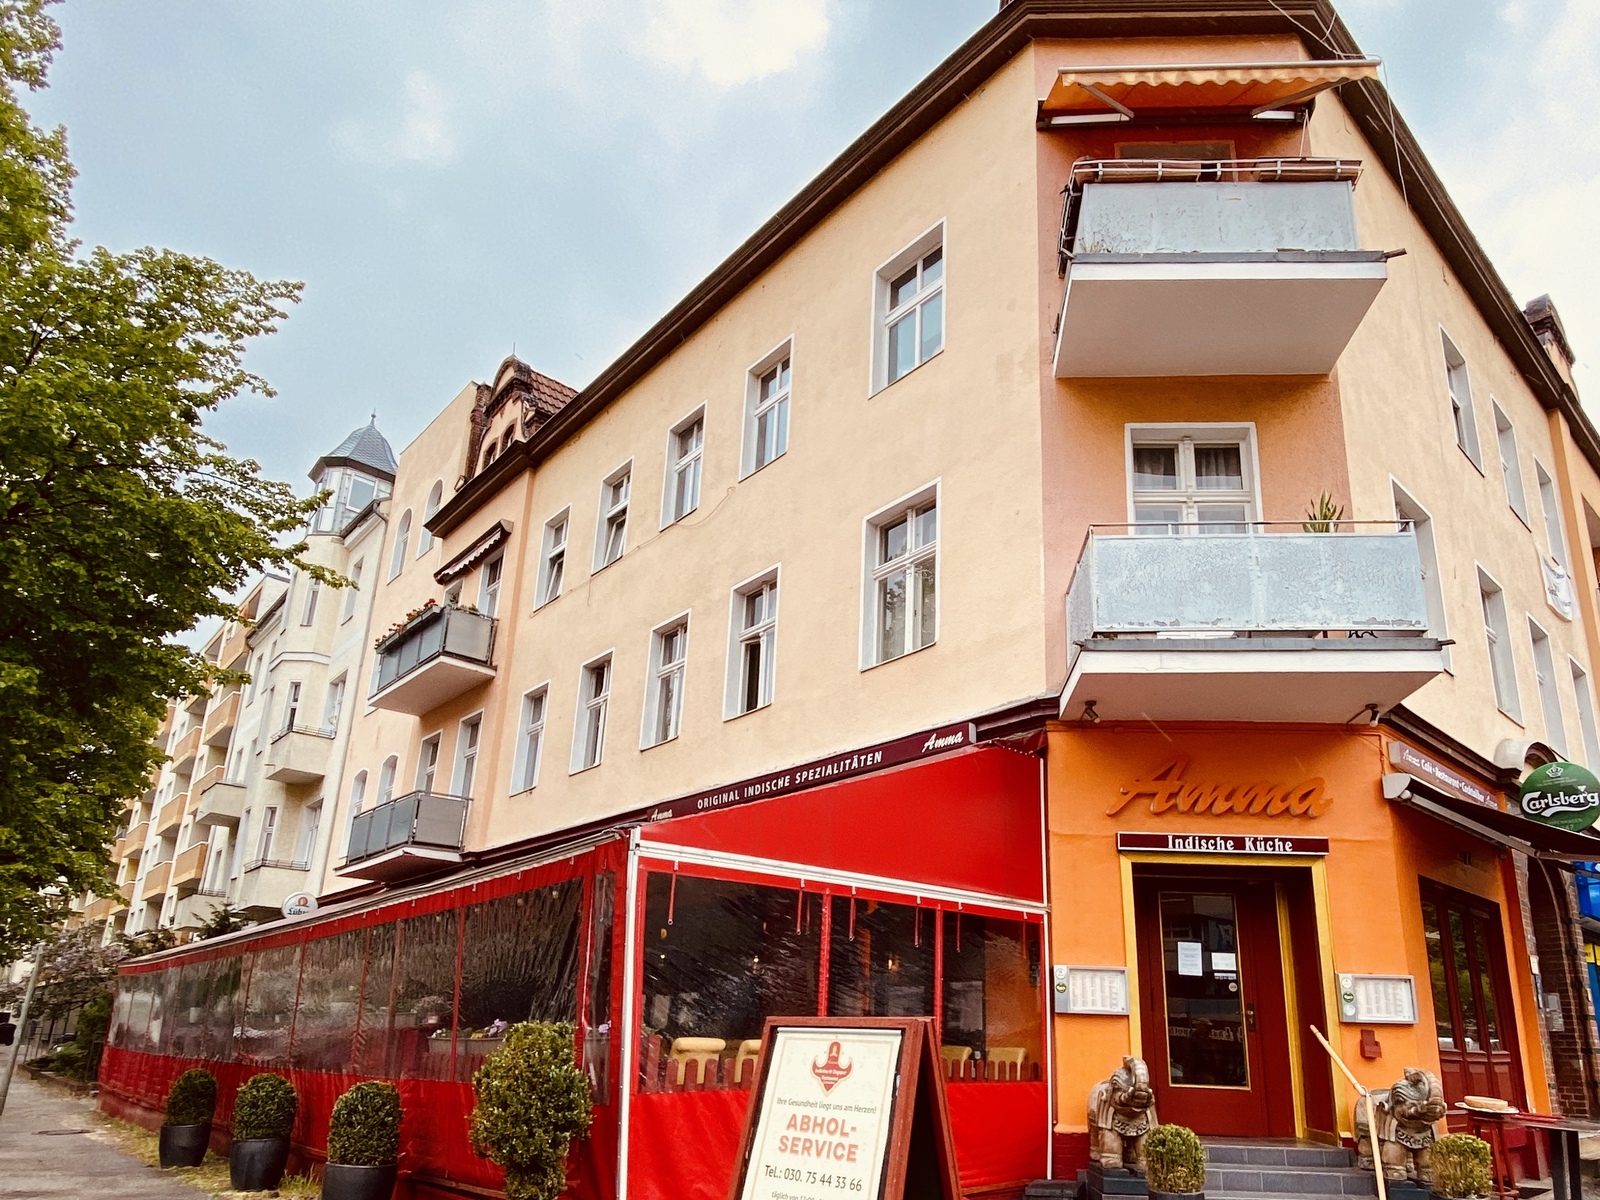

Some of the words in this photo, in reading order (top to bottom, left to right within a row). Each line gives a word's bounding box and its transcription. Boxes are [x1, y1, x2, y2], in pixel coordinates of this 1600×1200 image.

[921, 731, 963, 752] Amma
[697, 789, 740, 810] ORIGINAL
[744, 774, 790, 798] INDISCHE
[795, 750, 883, 784] SPEZIALITÄTEN
[1106, 757, 1334, 819] Amma
[1521, 790, 1600, 815] Carlsberg
[1167, 834, 1235, 851] Indische
[1244, 836, 1293, 853] Küche
[776, 1097, 788, 1106] Ihre
[788, 1098, 818, 1109] Gesundheit
[818, 1101, 832, 1112] liegt
[853, 1104, 877, 1115] Herzen!
[786, 1114, 857, 1137] ABHOL-
[778, 1135, 859, 1163] SERVICE
[764, 1165, 783, 1179] Tel.:
[783, 1168, 803, 1183] 030.
[805, 1171, 818, 1185] 75
[819, 1173, 833, 1187] 44
[834, 1176, 847, 1189] 33
[849, 1178, 863, 1192] 66
[771, 1190, 789, 1200] täglich
